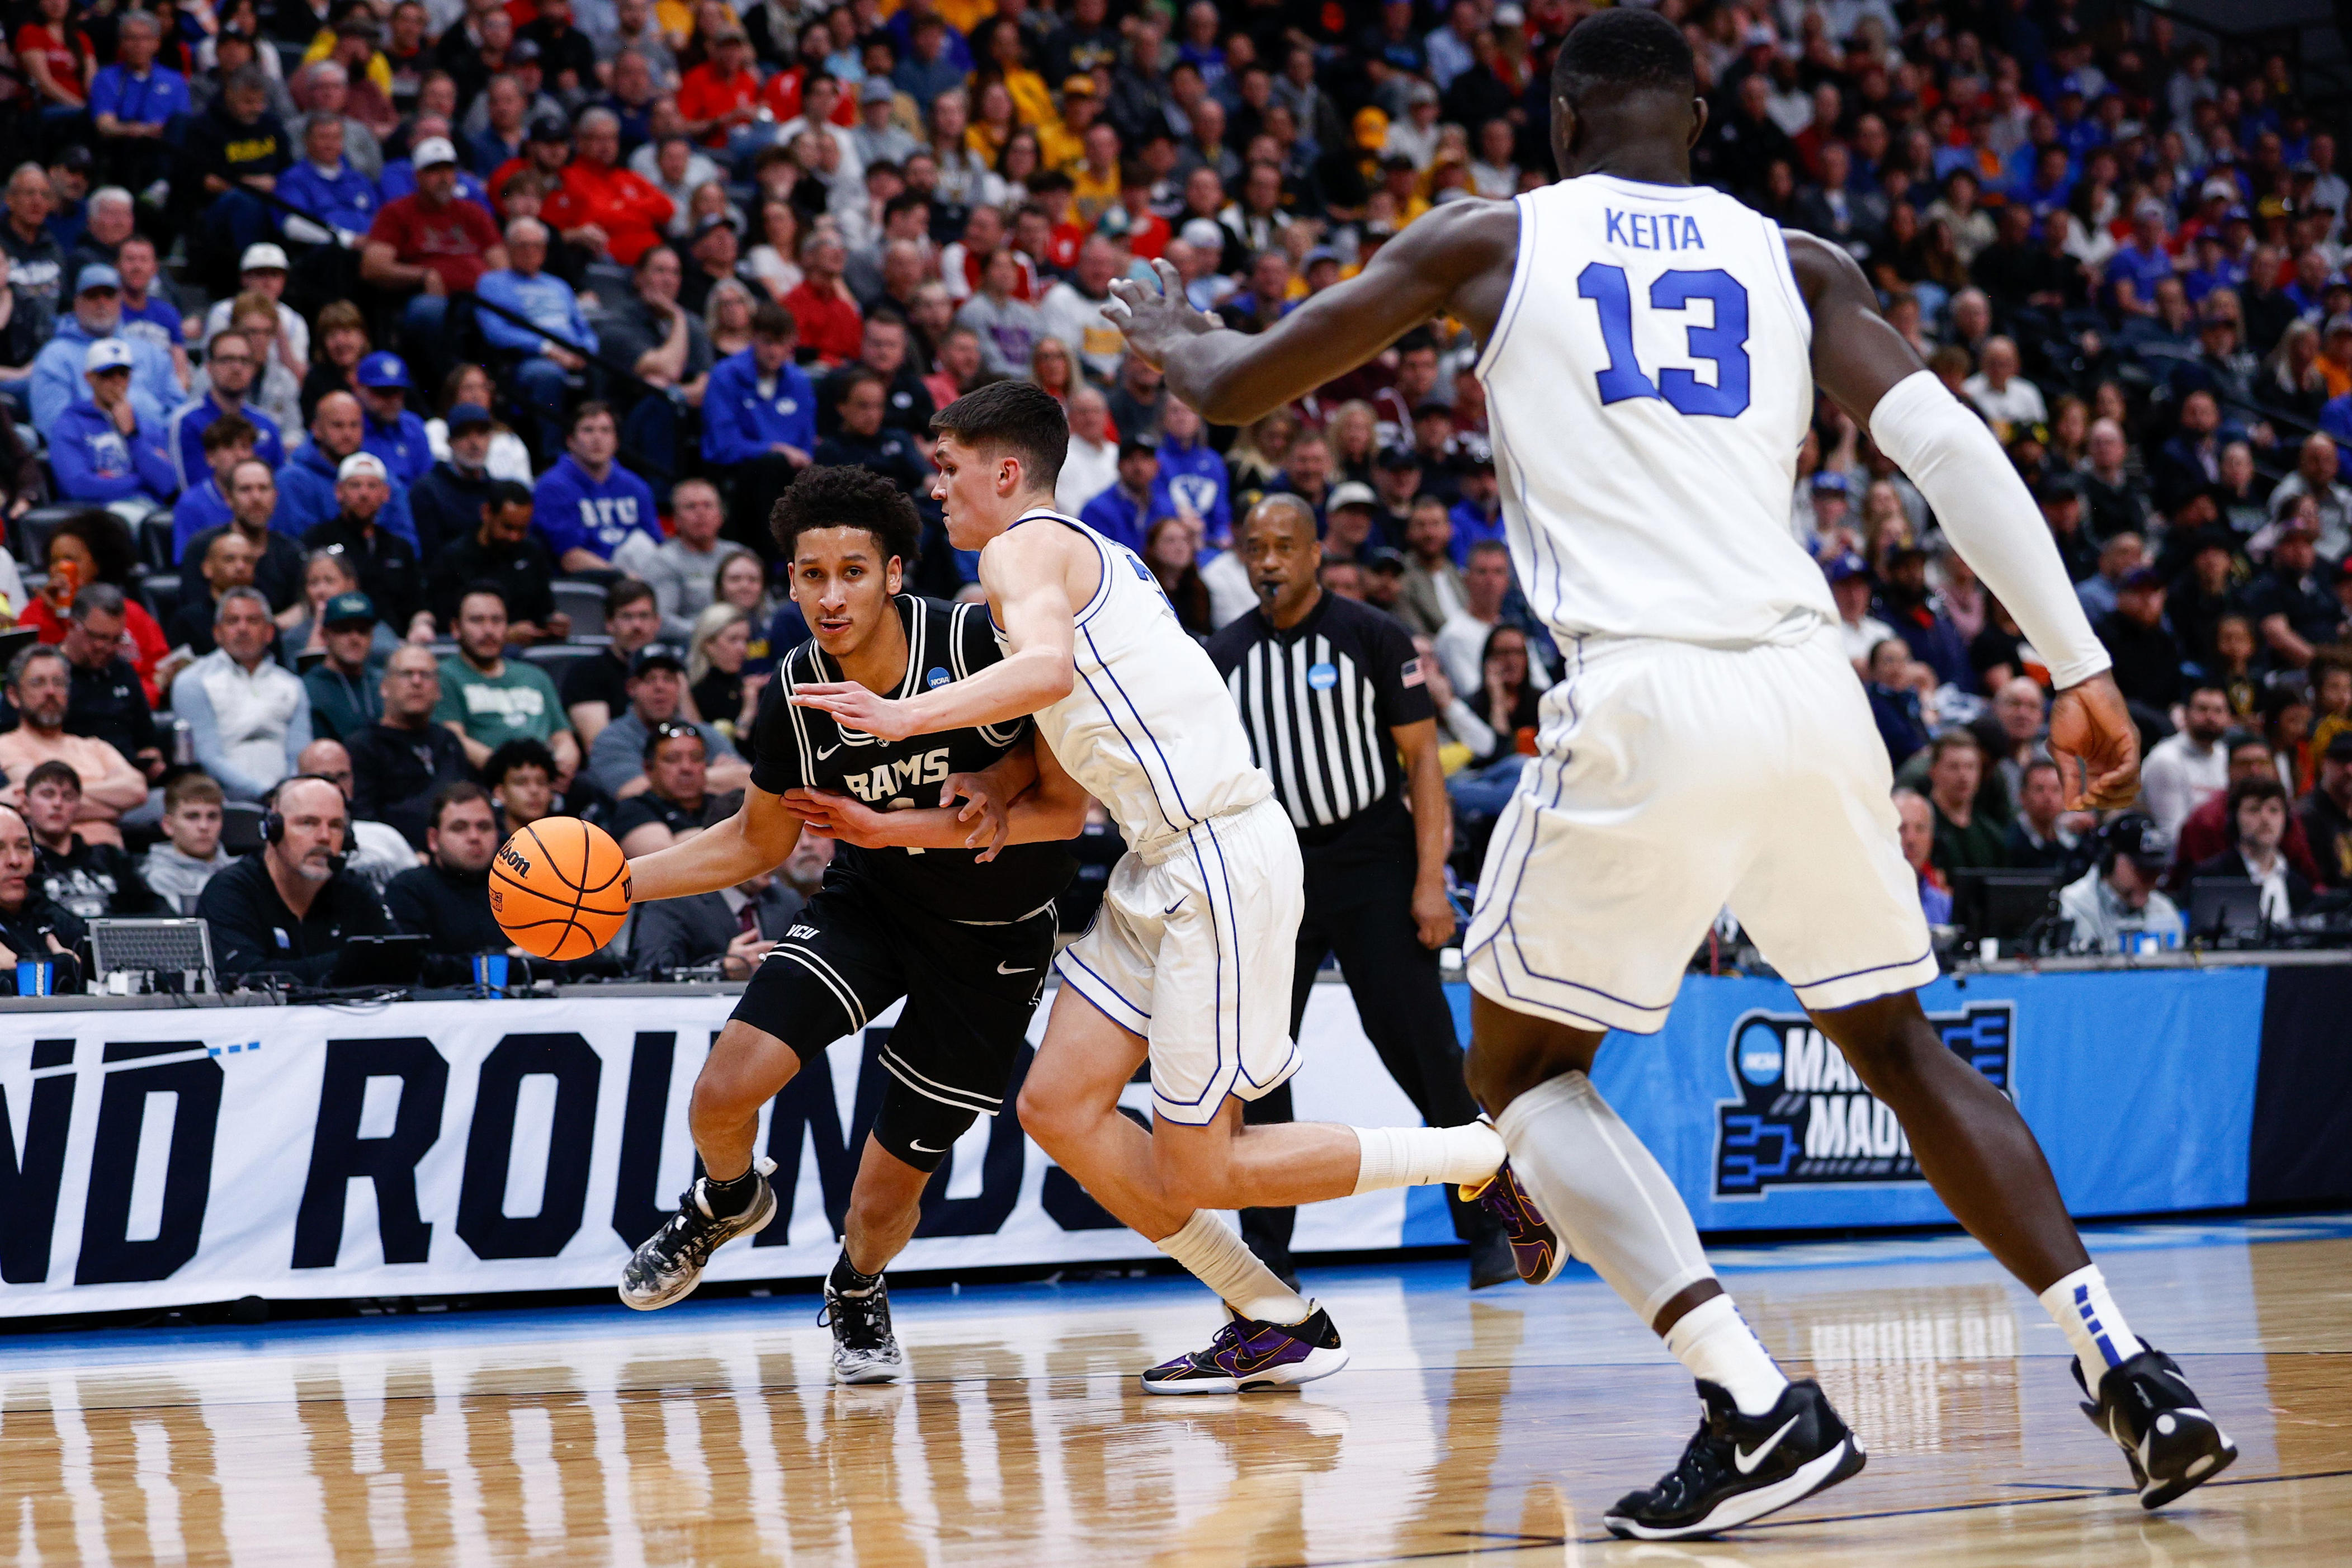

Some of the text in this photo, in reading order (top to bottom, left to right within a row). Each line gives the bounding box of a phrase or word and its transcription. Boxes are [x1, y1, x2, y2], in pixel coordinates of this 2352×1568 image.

[1605, 207, 1704, 251] KEITA
[1576, 262, 1751, 419] 13
[931, 676, 950, 686] NCAA
[843, 747, 950, 802] RAMS
[499, 837, 531, 879] lson
[785, 924, 821, 940] VCU
